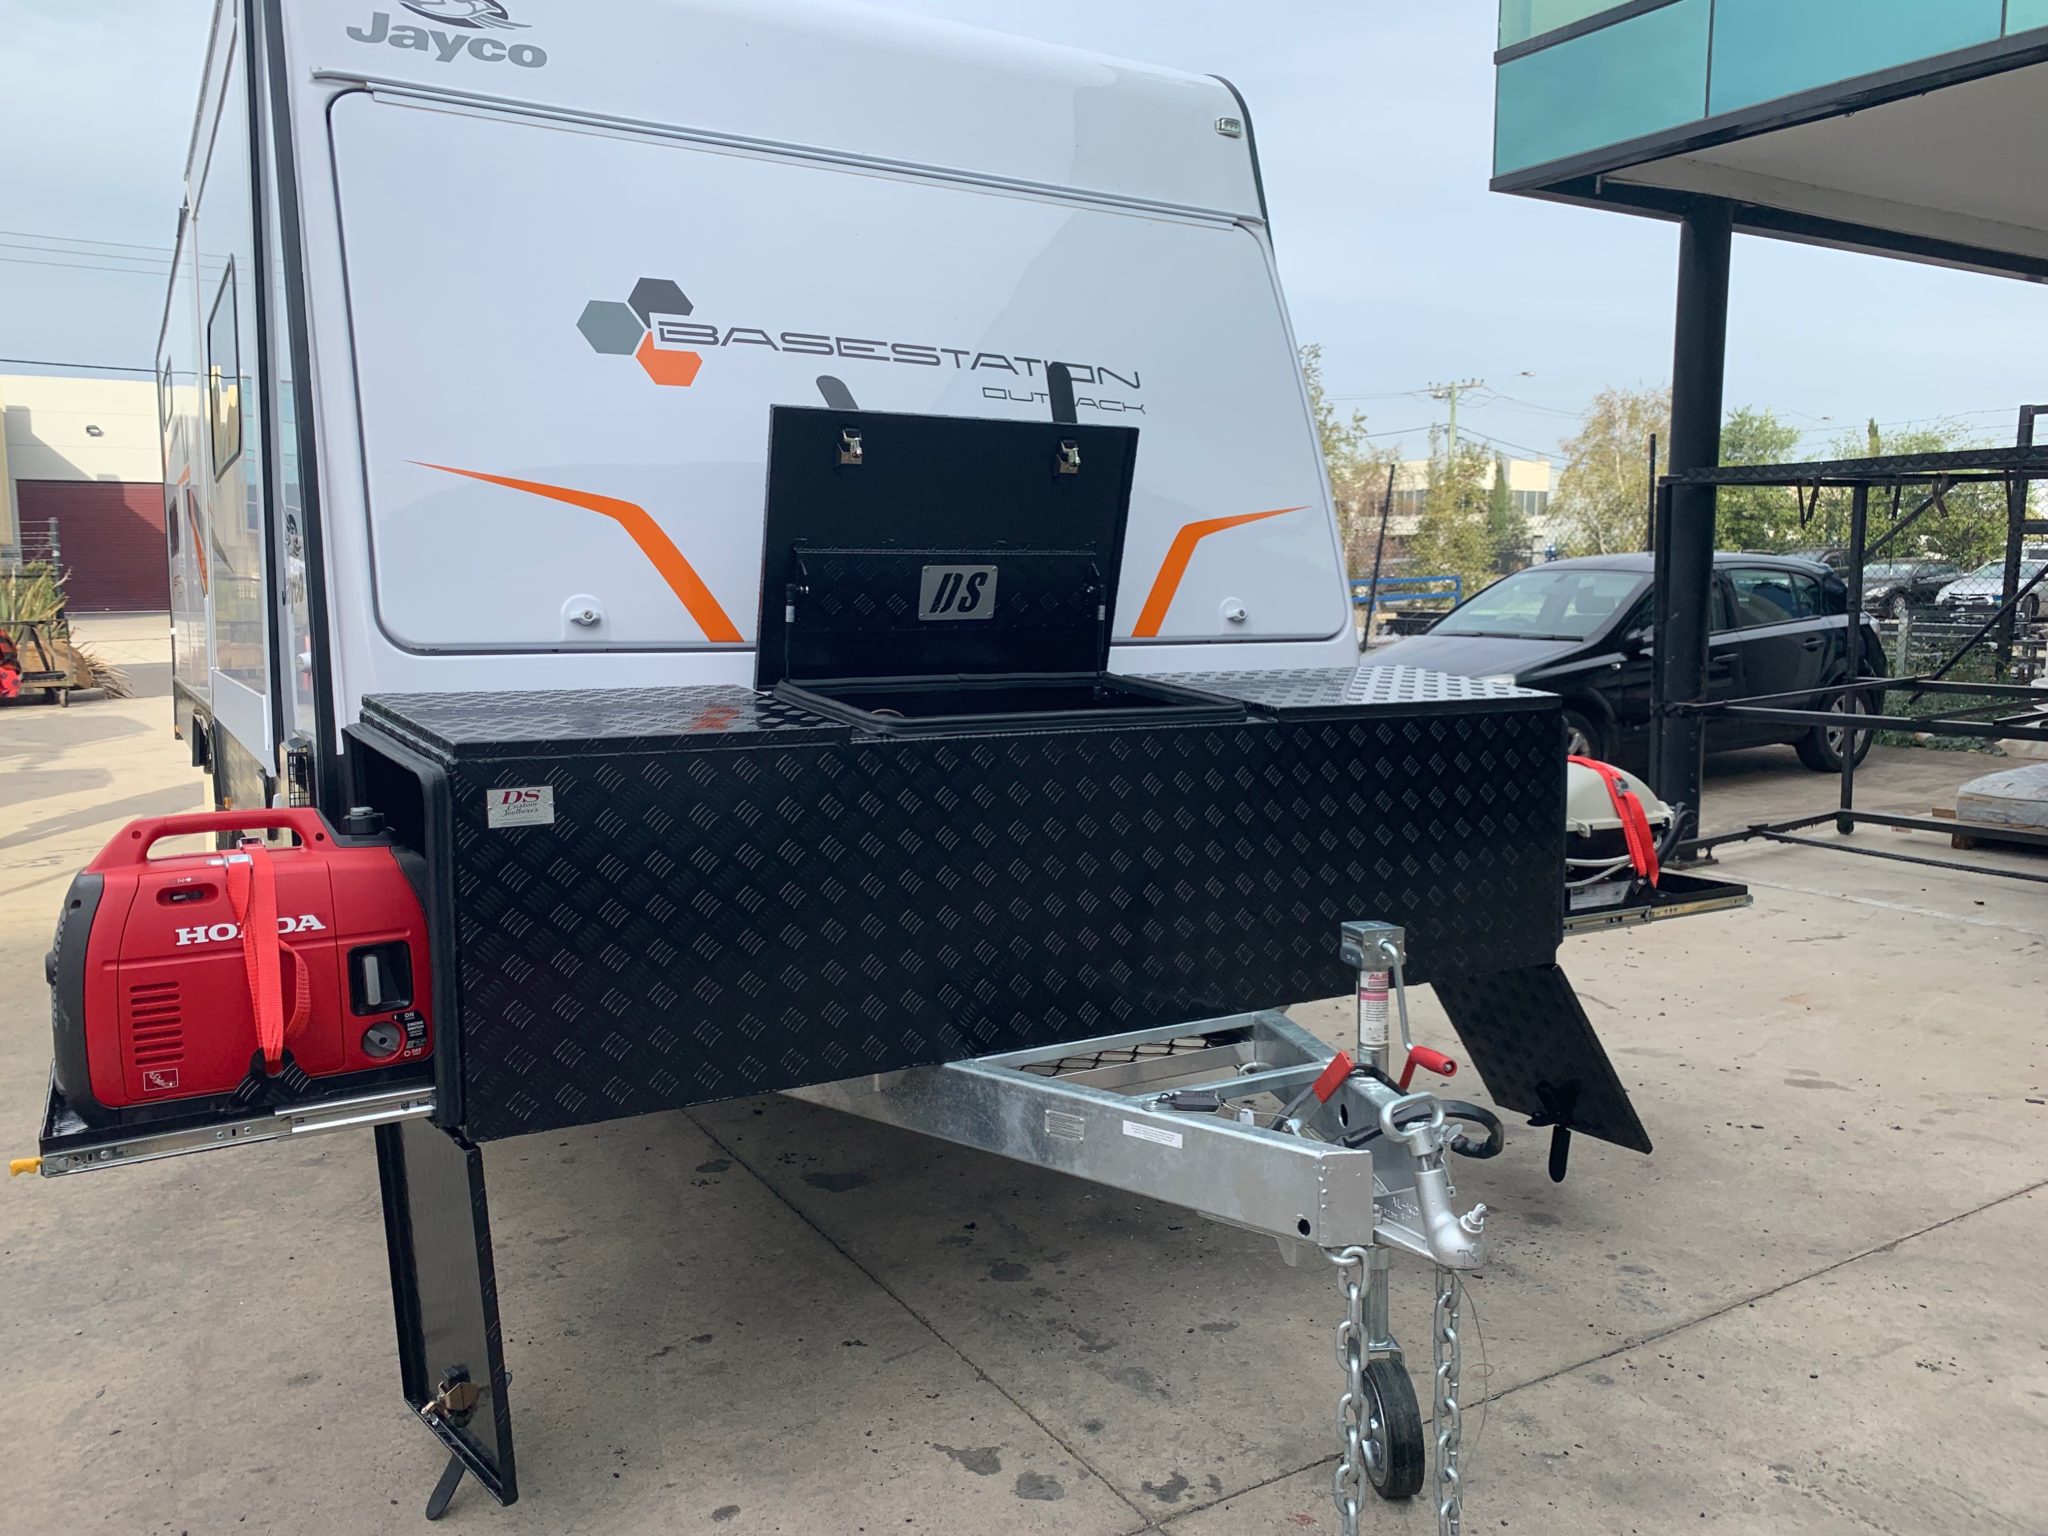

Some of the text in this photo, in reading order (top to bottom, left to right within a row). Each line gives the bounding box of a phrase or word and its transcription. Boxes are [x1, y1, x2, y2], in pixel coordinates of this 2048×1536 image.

[346, 12, 548, 68] Jayco
[982, 387, 1146, 414] OUTACK
[929, 572, 989, 613] DS
[501, 789, 541, 805] DS
[175, 914, 326, 946] HODA
